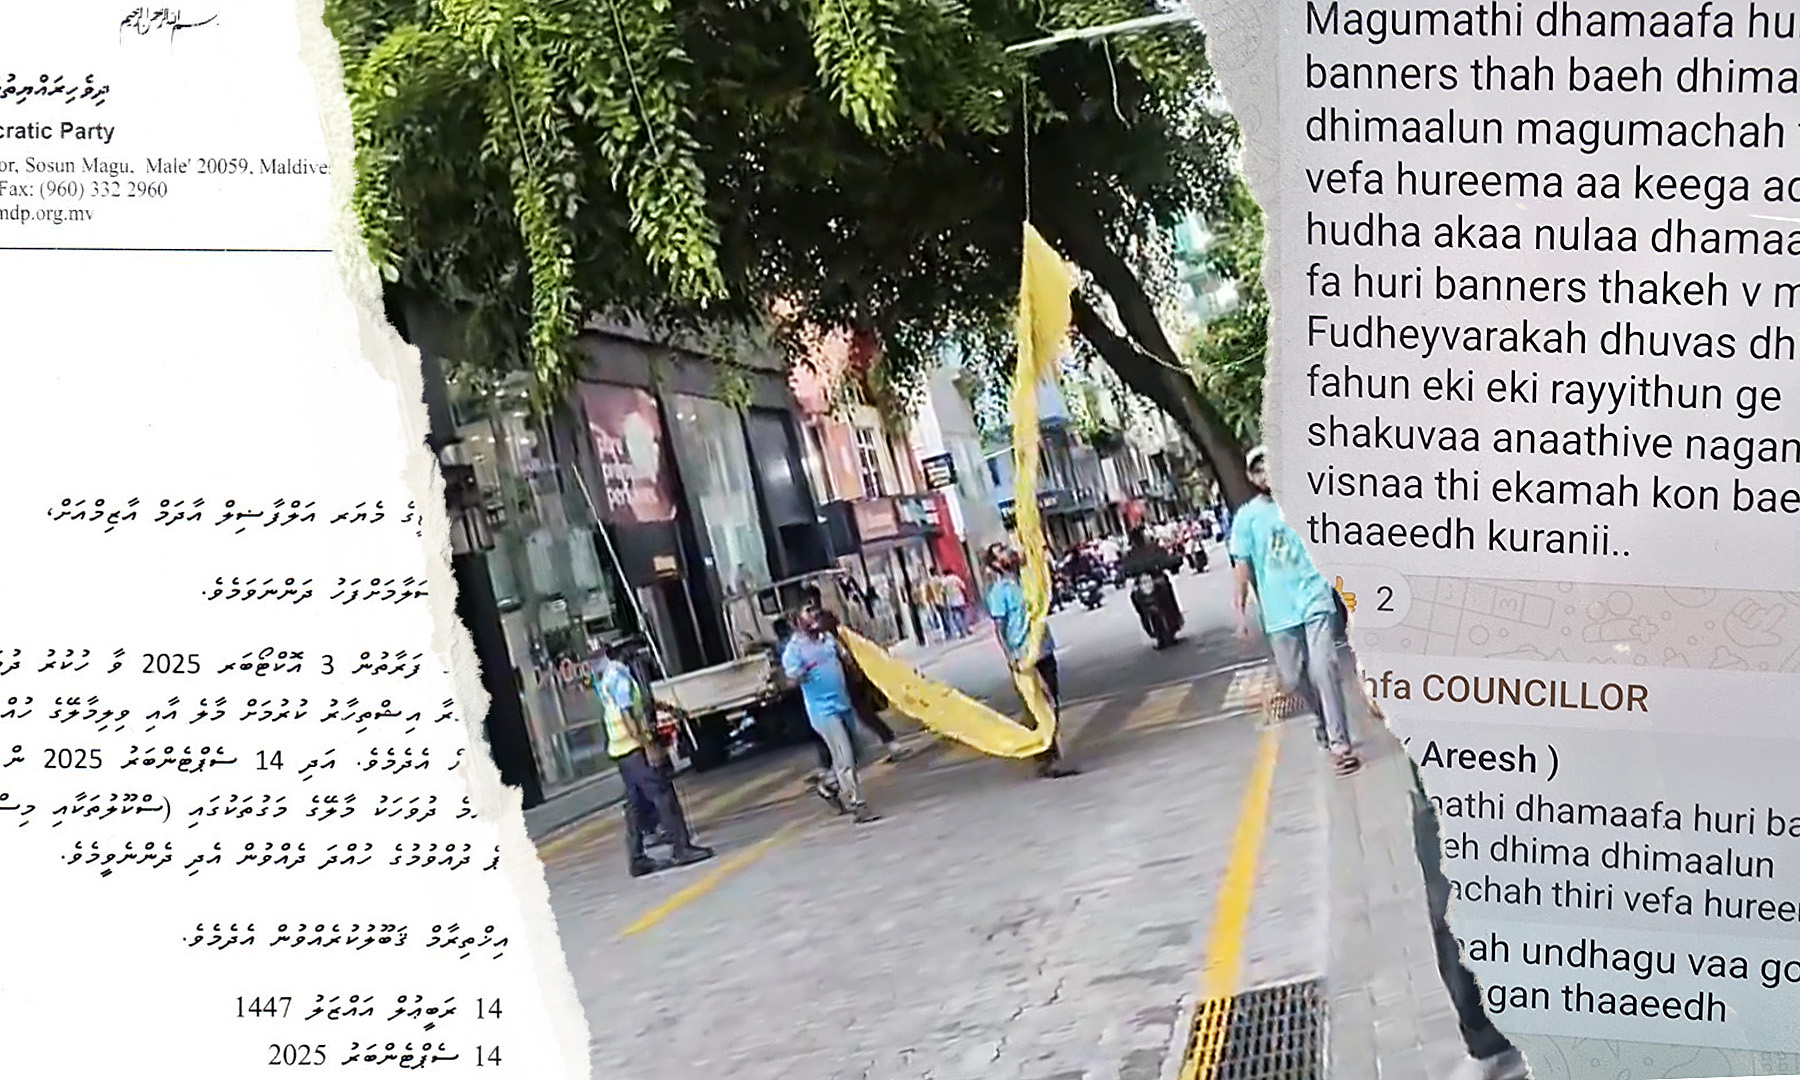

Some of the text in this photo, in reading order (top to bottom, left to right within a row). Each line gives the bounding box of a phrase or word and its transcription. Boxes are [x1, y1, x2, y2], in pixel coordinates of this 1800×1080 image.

[1307, 1, 1800, 44] Magumathi dhamaafa hu
[1307, 53, 1797, 94] banners thah baeh dhima
[0, 73, 110, 107] ދިވެހިރައްޔިތު
[61, 122, 115, 144] Party
[1306, 107, 1784, 154] dhimaalun magumachah
[26, 157, 75, 173] Sosun
[0, 180, 168, 200] Fax: (960) 332 2960
[1306, 160, 1383, 194] vefa
[1398, 161, 1562, 199] hureema
[1577, 174, 1620, 200] aa
[1635, 165, 1748, 210] keega
[1307, 211, 1420, 248] hudha
[1435, 214, 1521, 249] akaa
[1536, 217, 1636, 252] nulaa
[1306, 263, 1340, 296] fa
[1355, 264, 1421, 299] huri
[1436, 266, 1586, 303] banners
[1599, 270, 1727, 306] thakeh
[1742, 283, 1762, 307] v
[1308, 315, 1586, 358] Fudheyvarakah
[1601, 321, 1735, 359] dhuvas
[1307, 364, 1781, 419] fahun eki eki rayyithun ge
[1308, 414, 1800, 470] shakuvaa anaathive nagan
[1307, 465, 1800, 513] visnaa thi ekamah kon bae
[155, 498, 205, 527] އާދަމް
[330, 501, 385, 524] މެޔަރ
[1307, 512, 1630, 556] thaaeedh kuranii..
[1377, 586, 1395, 612] 2
[38, 649, 90, 673] ހުކުރު
[107, 648, 126, 674] ވާ
[142, 653, 201, 674] 2025
[321, 655, 335, 675] 3
[352, 650, 423, 679] ފަރާތުން
[1423, 674, 1649, 712] COUNCILLOR
[48, 696, 130, 732] ވިލިމާލޭގެ
[145, 696, 180, 733] އާއި
[189, 697, 227, 725] މާލެ
[240, 698, 309, 723] ކުރުމަށް
[3, 745, 25, 768] ން
[44, 748, 102, 770] 2025
[256, 750, 284, 771] 14
[298, 749, 336, 782] އަދި
[357, 747, 430, 775] އެދެމެވެ.
[1421, 741, 1536, 774] Areesh
[305, 794, 357, 822] މާލޭގެ
[375, 795, 437, 823] ދުވަހަކު
[1516, 794, 1682, 831] dhamaafa
[1694, 803, 1755, 835] huri
[1767, 807, 1800, 838] ba
[184, 842, 222, 877] އެދި
[236, 843, 306, 870] ދެއްވުން
[317, 843, 373, 870] ހުއްދަ
[389, 843, 472, 871] ދުއްވުމުގެ
[1445, 832, 1774, 878] eh dhima dhimaalun
[1551, 880, 1613, 911] thiri
[1624, 886, 1692, 915] vefa
[1704, 889, 1800, 922] huree
[183, 923, 255, 950] އެދެމެވެ.
[1457, 932, 1509, 963] ah
[1523, 938, 1675, 979] undhagu
[1688, 953, 1748, 979] vaa
[236, 996, 292, 1018] 1447
[478, 997, 503, 1019] 14
[1487, 983, 1726, 1022] gan thaaeedh
[268, 1043, 326, 1066] 2025
[476, 1046, 502, 1067] 14
